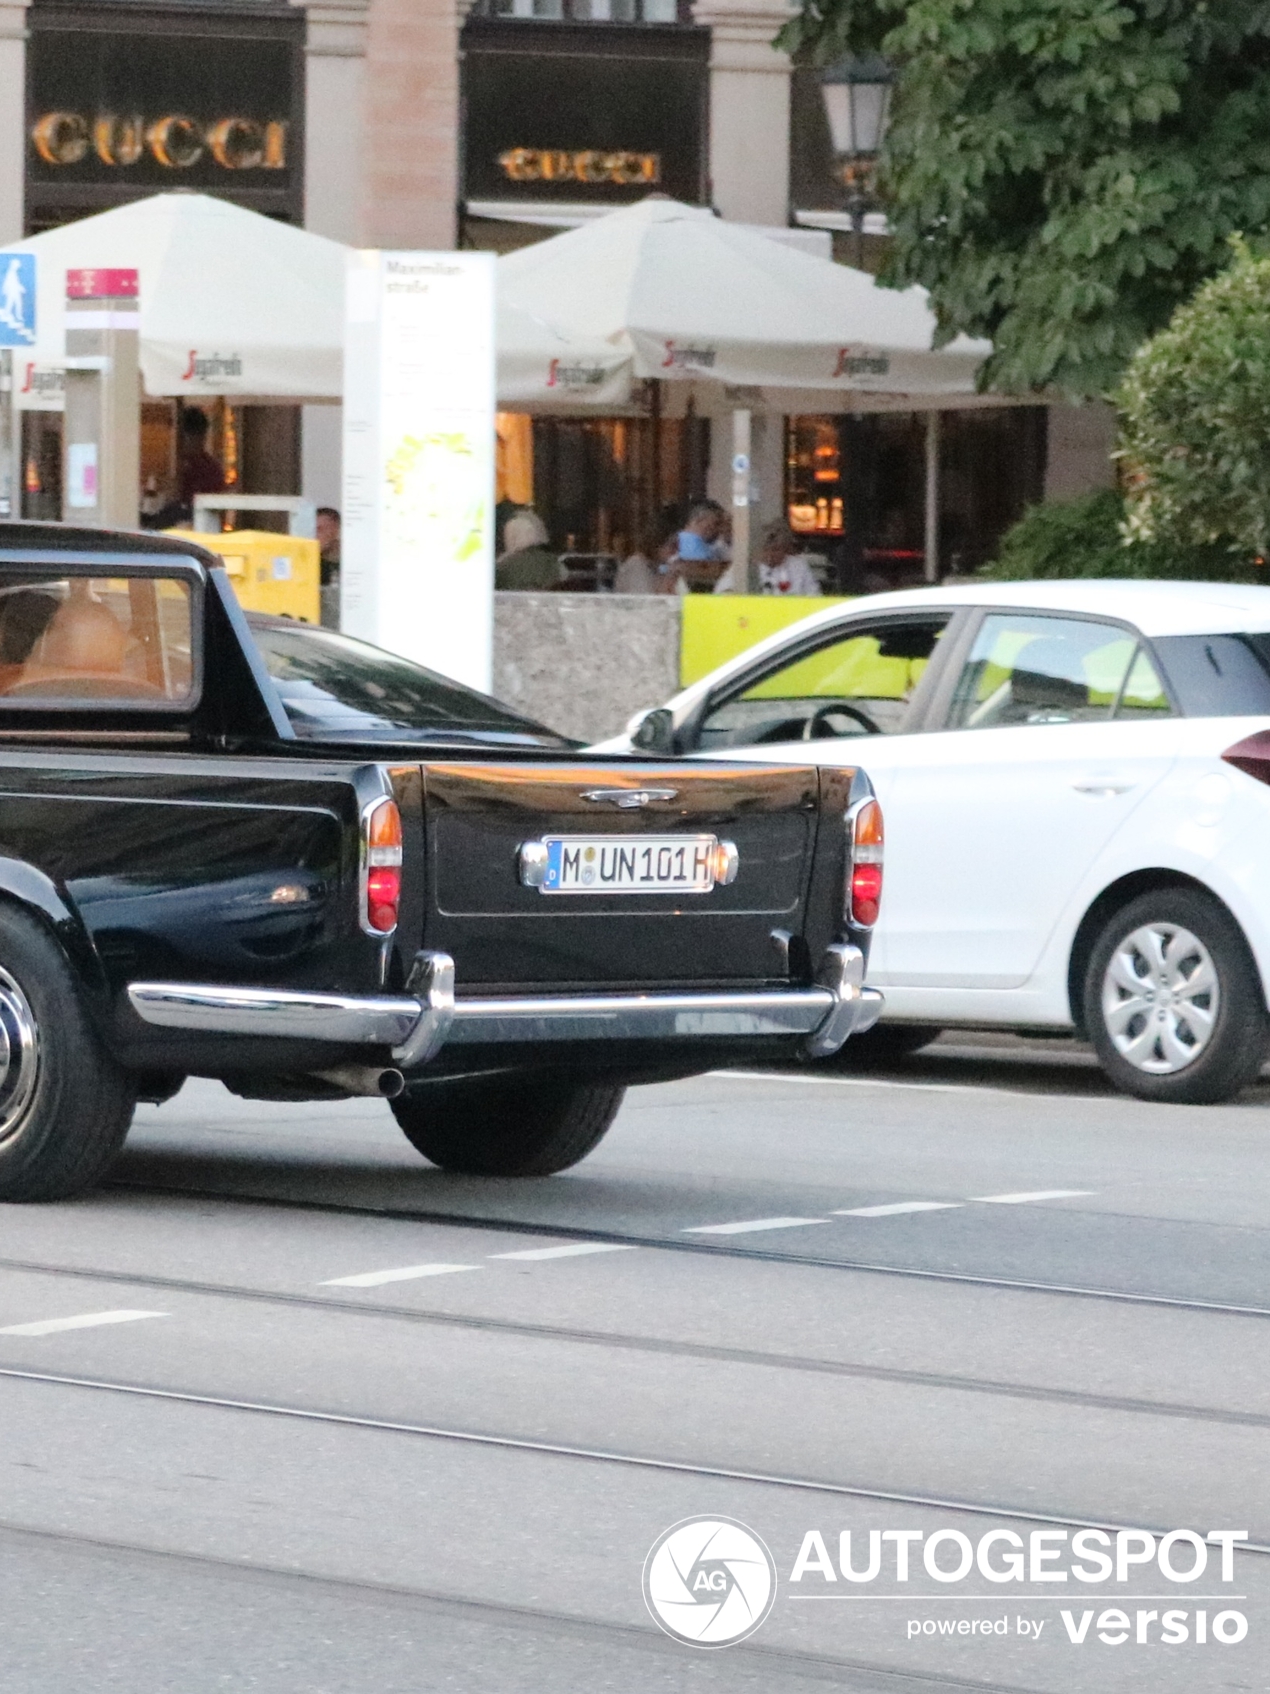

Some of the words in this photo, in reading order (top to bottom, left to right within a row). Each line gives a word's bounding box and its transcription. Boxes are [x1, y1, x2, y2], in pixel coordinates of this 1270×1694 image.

[33, 112, 286, 169] GUCCI
[499, 147, 660, 184] GUCCI
[386, 260, 466, 276] Maximilian-
[386, 280, 429, 294] straße
[562, 847, 581, 882] M
